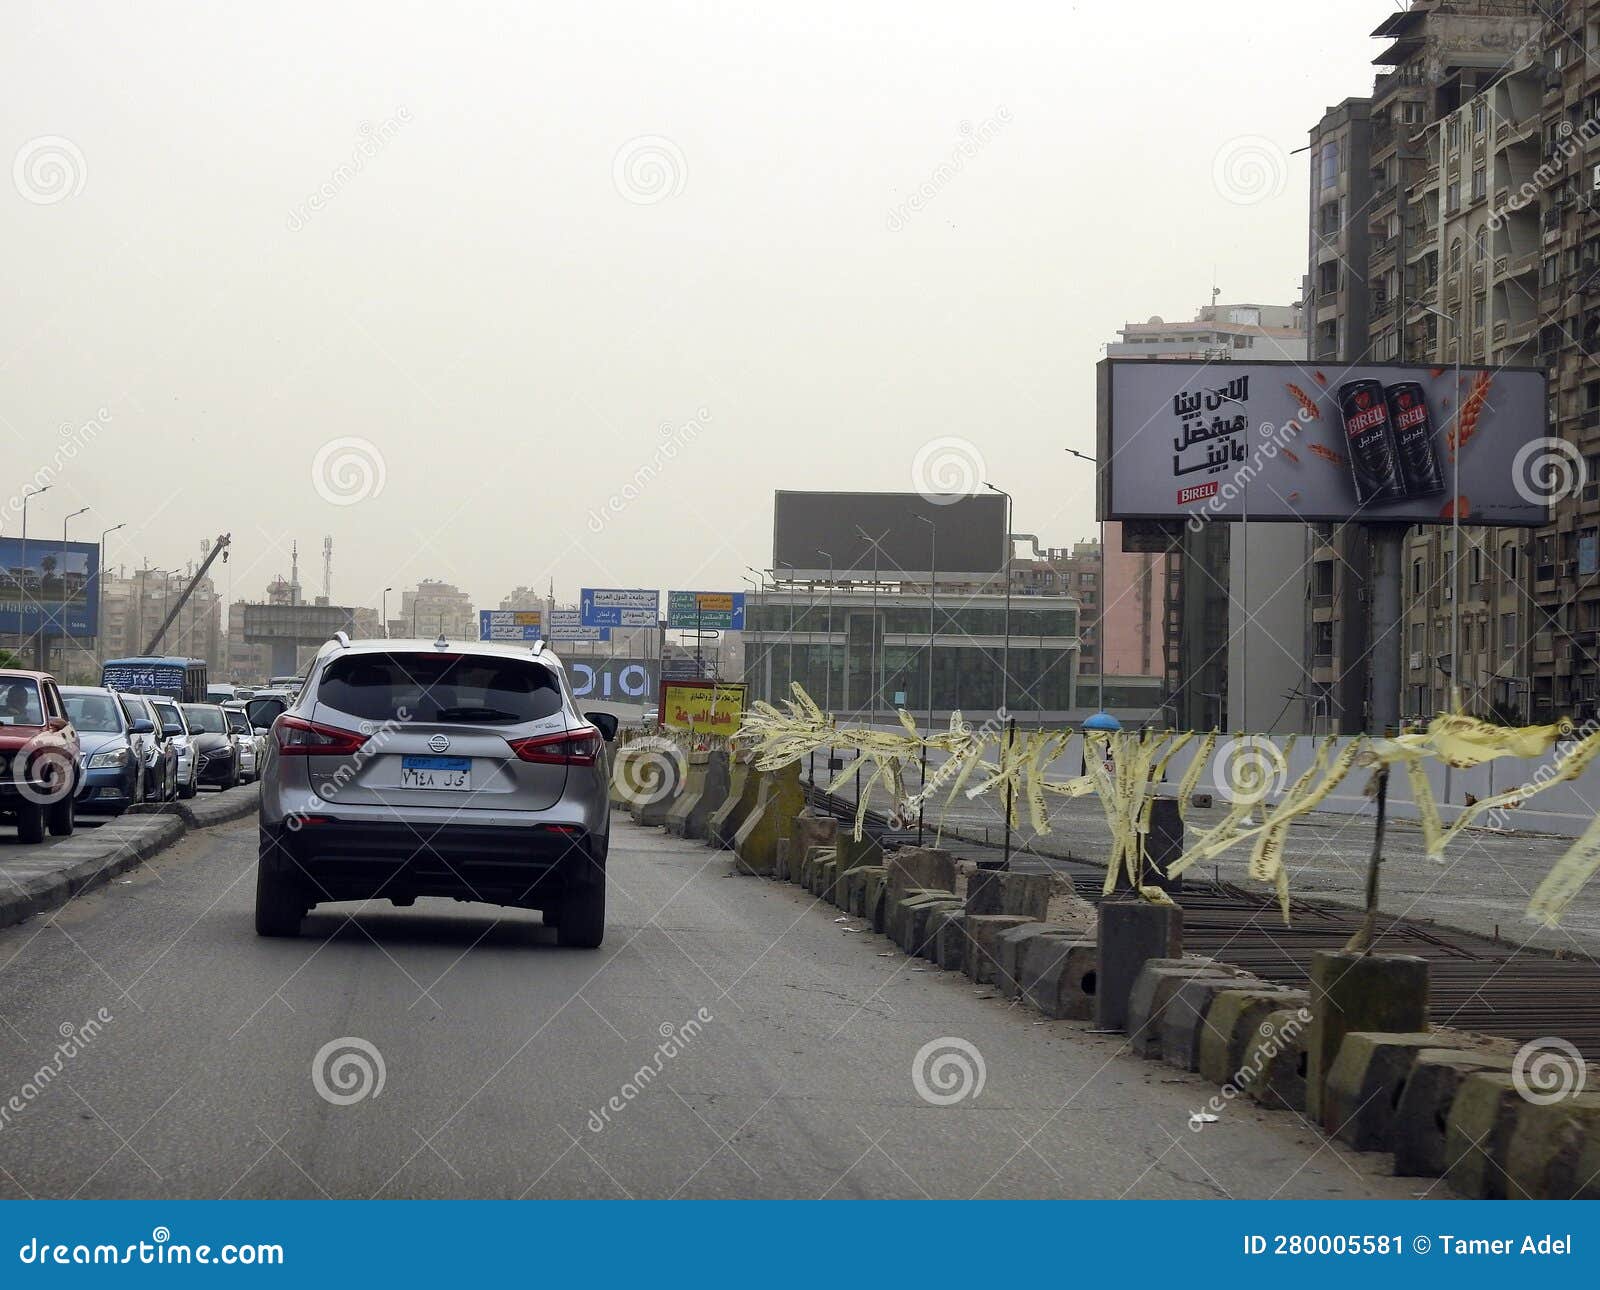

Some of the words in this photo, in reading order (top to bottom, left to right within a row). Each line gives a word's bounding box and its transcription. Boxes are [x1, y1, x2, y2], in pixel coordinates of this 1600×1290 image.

[1348, 408, 1385, 434] BIRELL
[1398, 408, 1425, 428] IRELL
[1182, 484, 1216, 503] BIRELL
